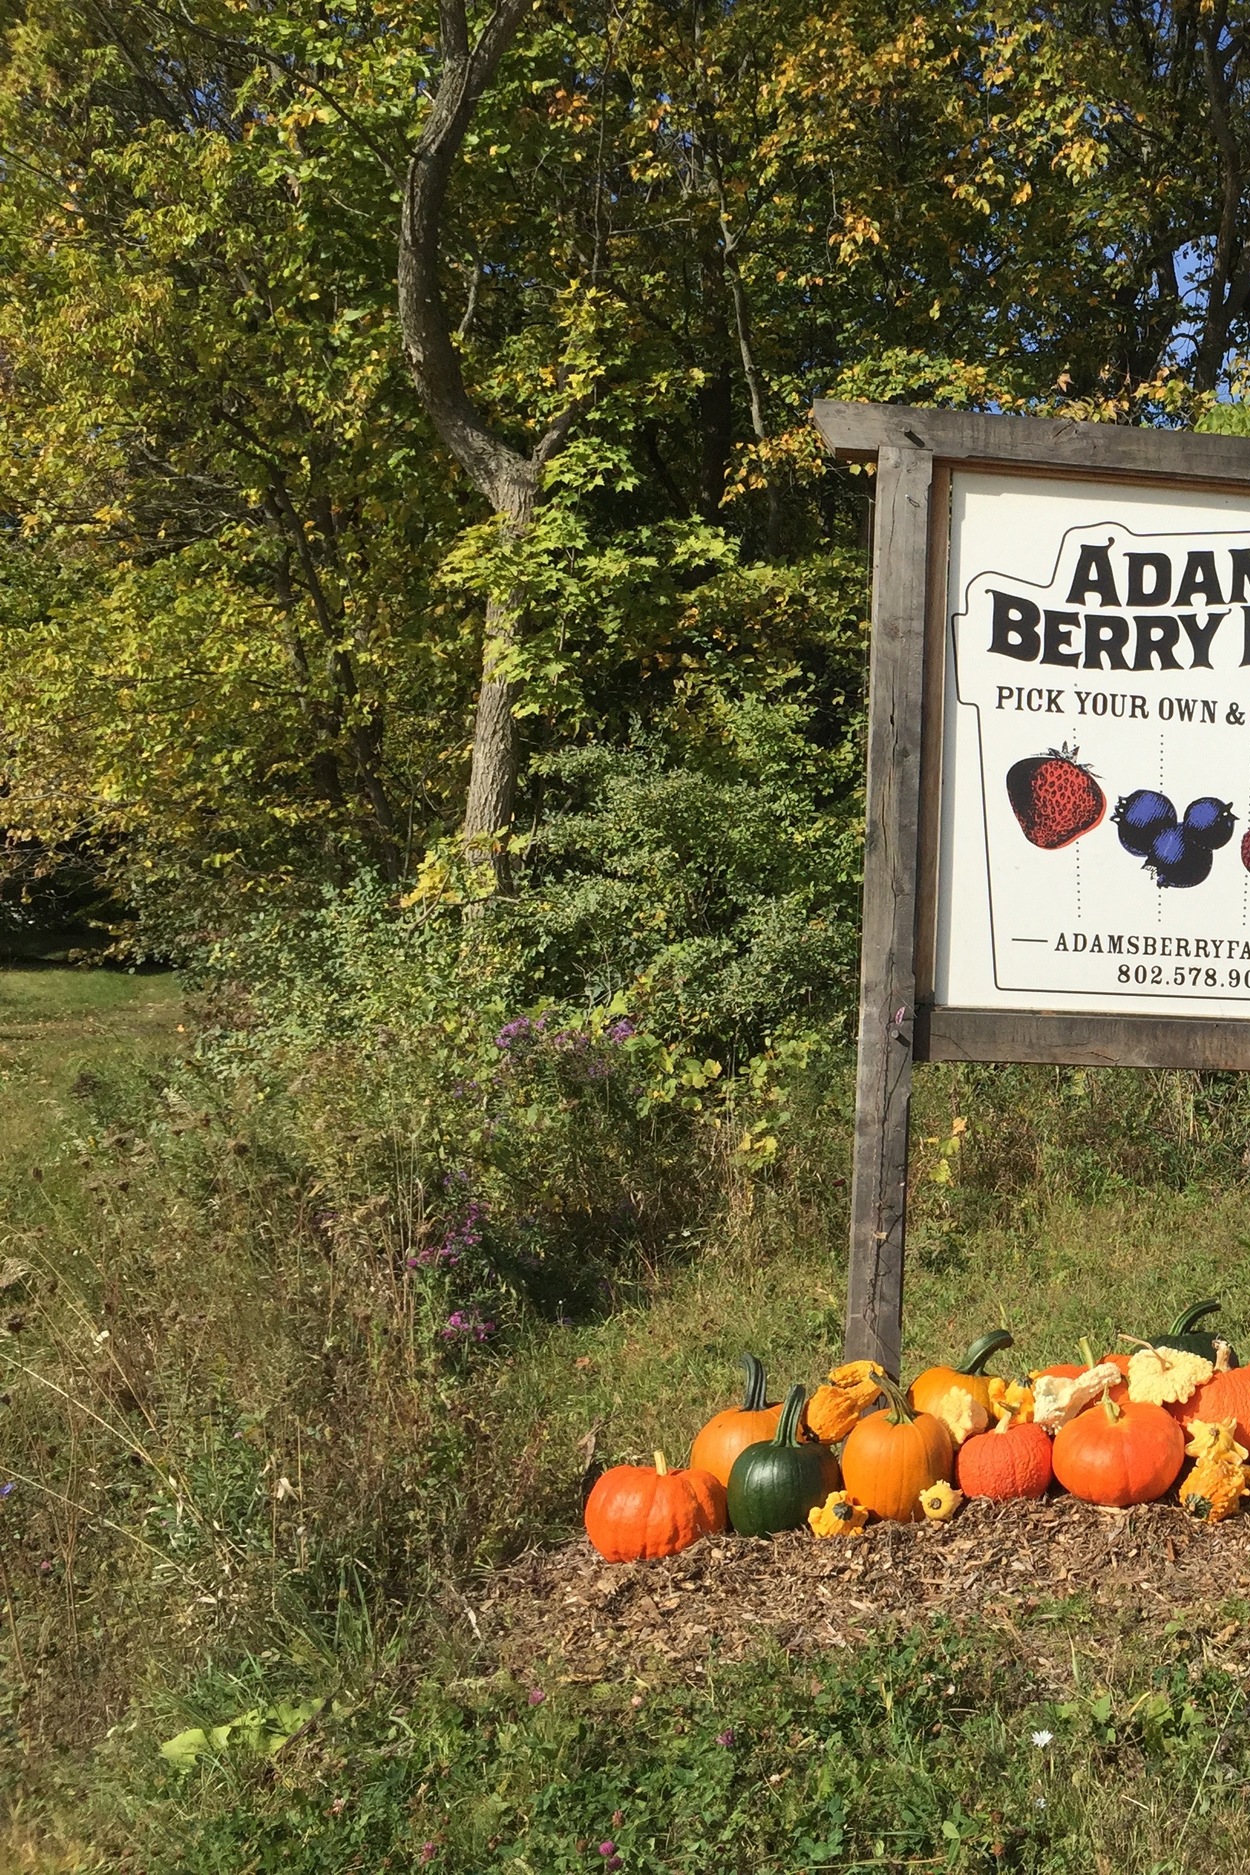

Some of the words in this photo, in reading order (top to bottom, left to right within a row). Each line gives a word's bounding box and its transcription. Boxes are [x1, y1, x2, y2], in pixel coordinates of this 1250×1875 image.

[985, 589, 1232, 672] BERRY
[995, 685, 1065, 714] PICK
[1074, 691, 1150, 720] YOUR
[1158, 697, 1218, 725] OWN
[1225, 702, 1246, 726] &
